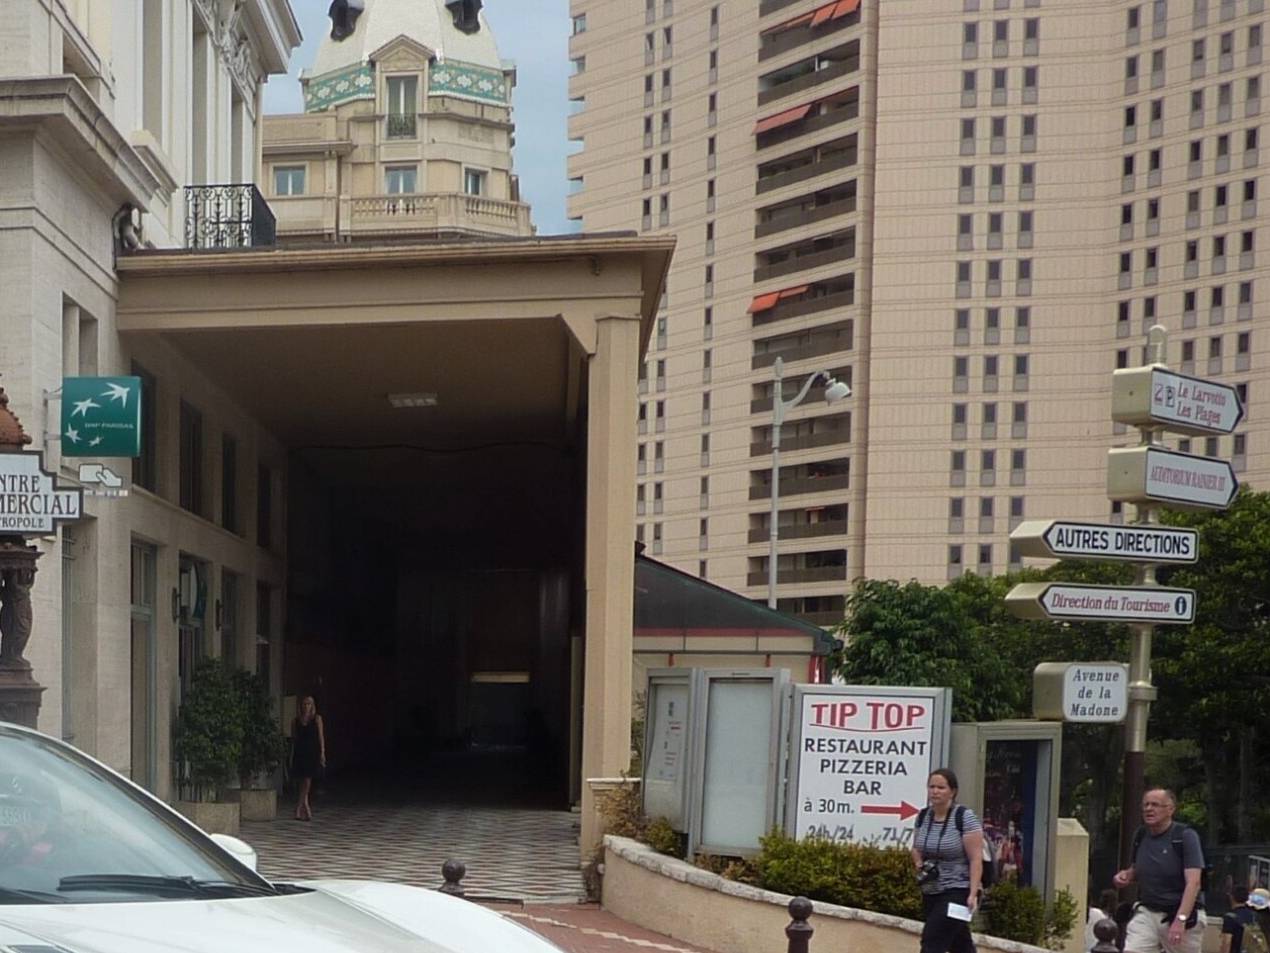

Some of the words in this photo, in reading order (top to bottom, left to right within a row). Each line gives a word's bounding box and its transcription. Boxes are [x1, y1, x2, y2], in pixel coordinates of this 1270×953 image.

[1177, 382, 1188, 398] Le
[1176, 401, 1192, 418] Les
[1194, 405, 1222, 426] Plages
[1055, 528, 1109, 550] AUTRES
[1115, 532, 1190, 555] DIRECTIONS
[1051, 593, 1102, 611] Direction
[1103, 596, 1119, 611] du
[1120, 598, 1170, 613] Tourisme
[1073, 669, 1120, 682] Avenue
[1077, 686, 1092, 699] de
[1099, 686, 1111, 699] la
[811, 703, 858, 728] TIP
[866, 702, 925, 729] TOP
[1070, 703, 1118, 717] Madone
[804, 738, 927, 755] RESTAURANT
[820, 759, 908, 776] PIZZERIA
[843, 780, 882, 795] BAR
[804, 798, 813, 812] à
